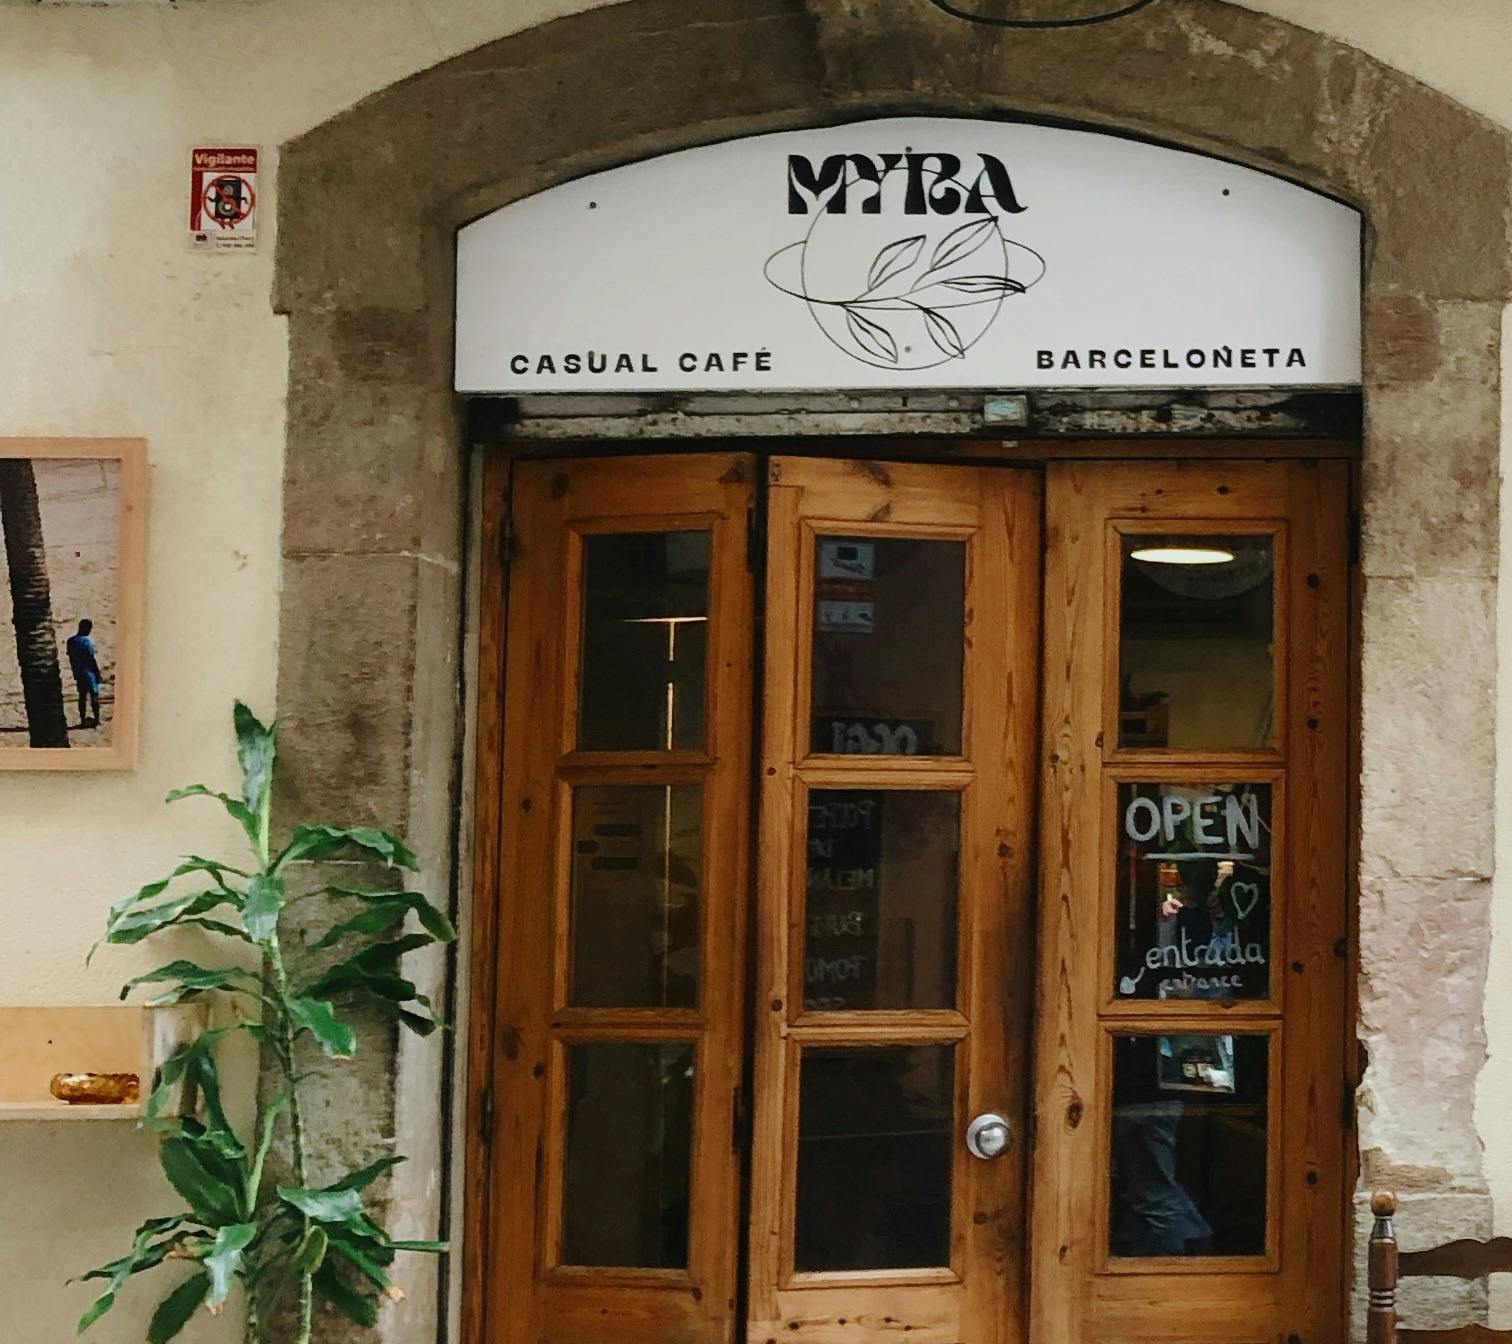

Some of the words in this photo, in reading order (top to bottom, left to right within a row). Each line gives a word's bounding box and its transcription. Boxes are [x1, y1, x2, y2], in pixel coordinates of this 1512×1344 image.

[194, 153, 255, 167] Vigilante
[787, 152, 1029, 216] MYRA
[510, 351, 660, 376] CASUAL
[678, 347, 775, 373] CAFÉ
[1036, 347, 1309, 370] BARCELONETA
[1126, 796, 1260, 849] OPEN
[1145, 926, 1266, 969] entrada
